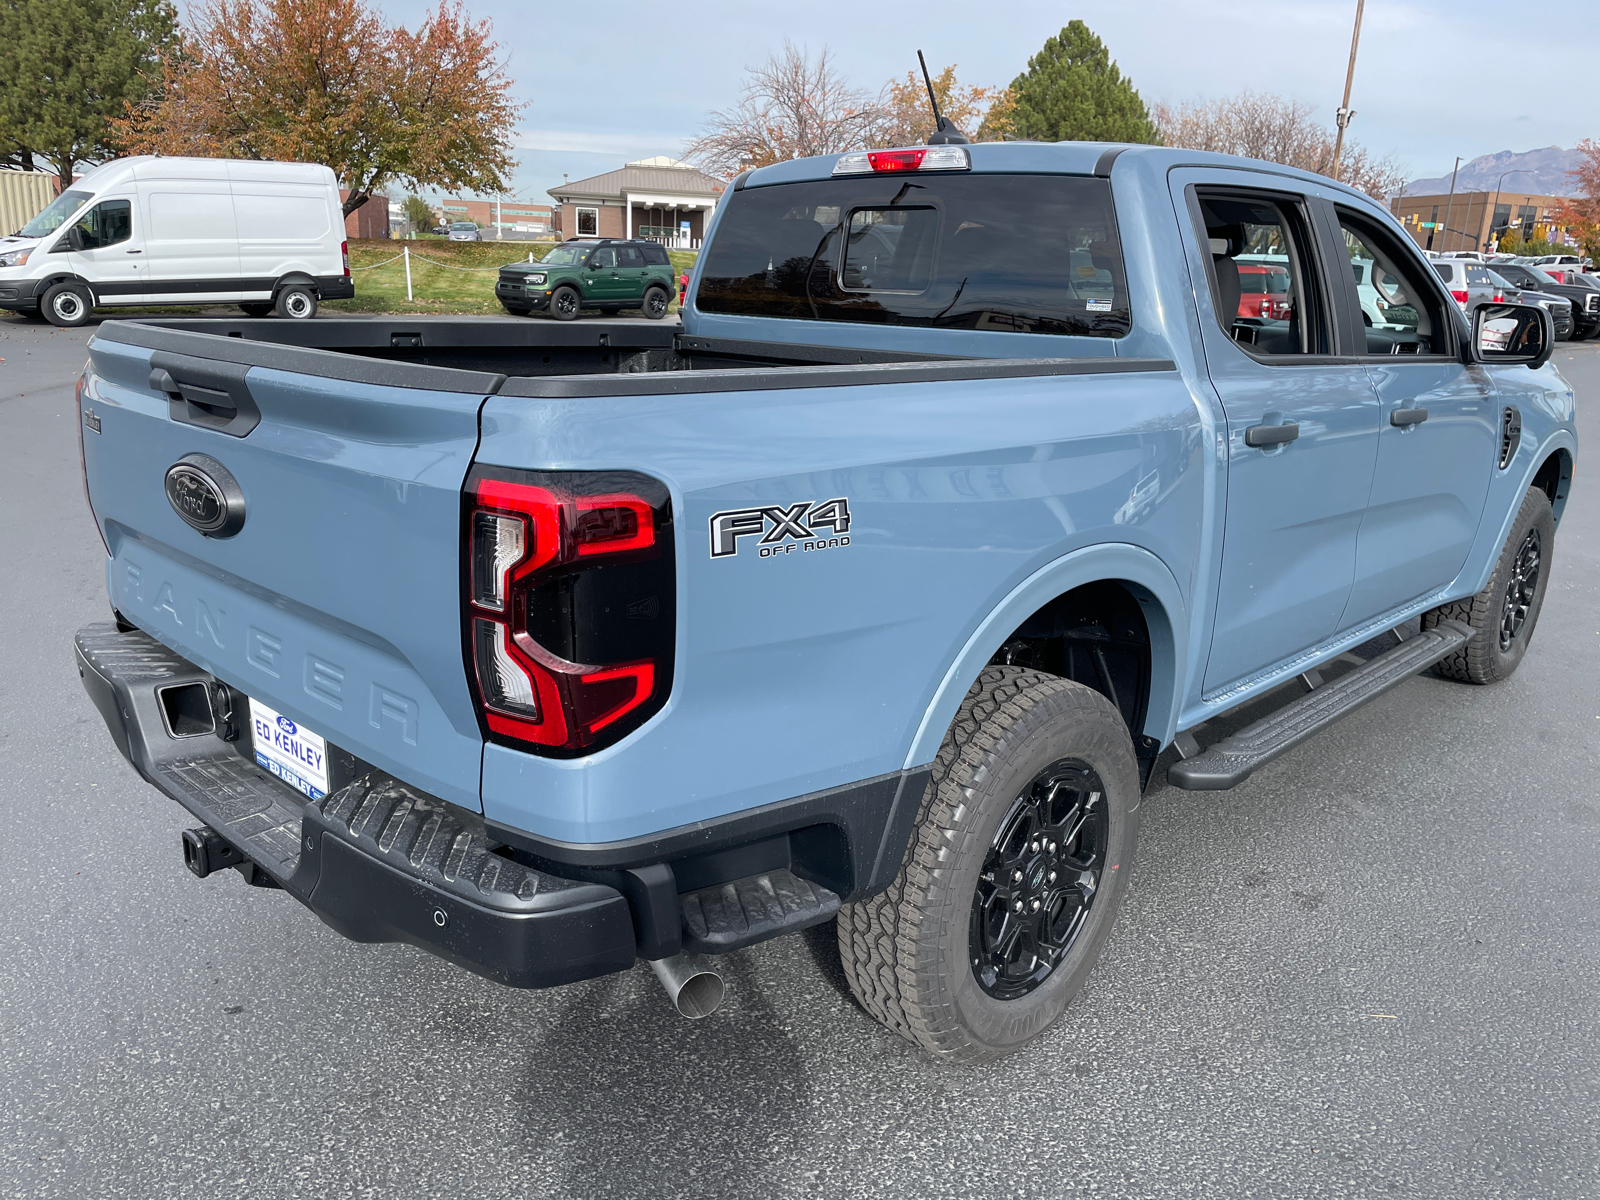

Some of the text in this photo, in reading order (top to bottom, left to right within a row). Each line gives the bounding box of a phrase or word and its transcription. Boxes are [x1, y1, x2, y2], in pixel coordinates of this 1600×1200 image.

[709, 497, 851, 559] FX4
[759, 536, 850, 558] OFF ROAD
[122, 558, 420, 747] RANGER
[256, 719, 271, 741] ED
[274, 729, 322, 770] KENLEY
[269, 760, 280, 776] ED
[281, 768, 312, 796] KENLEY
